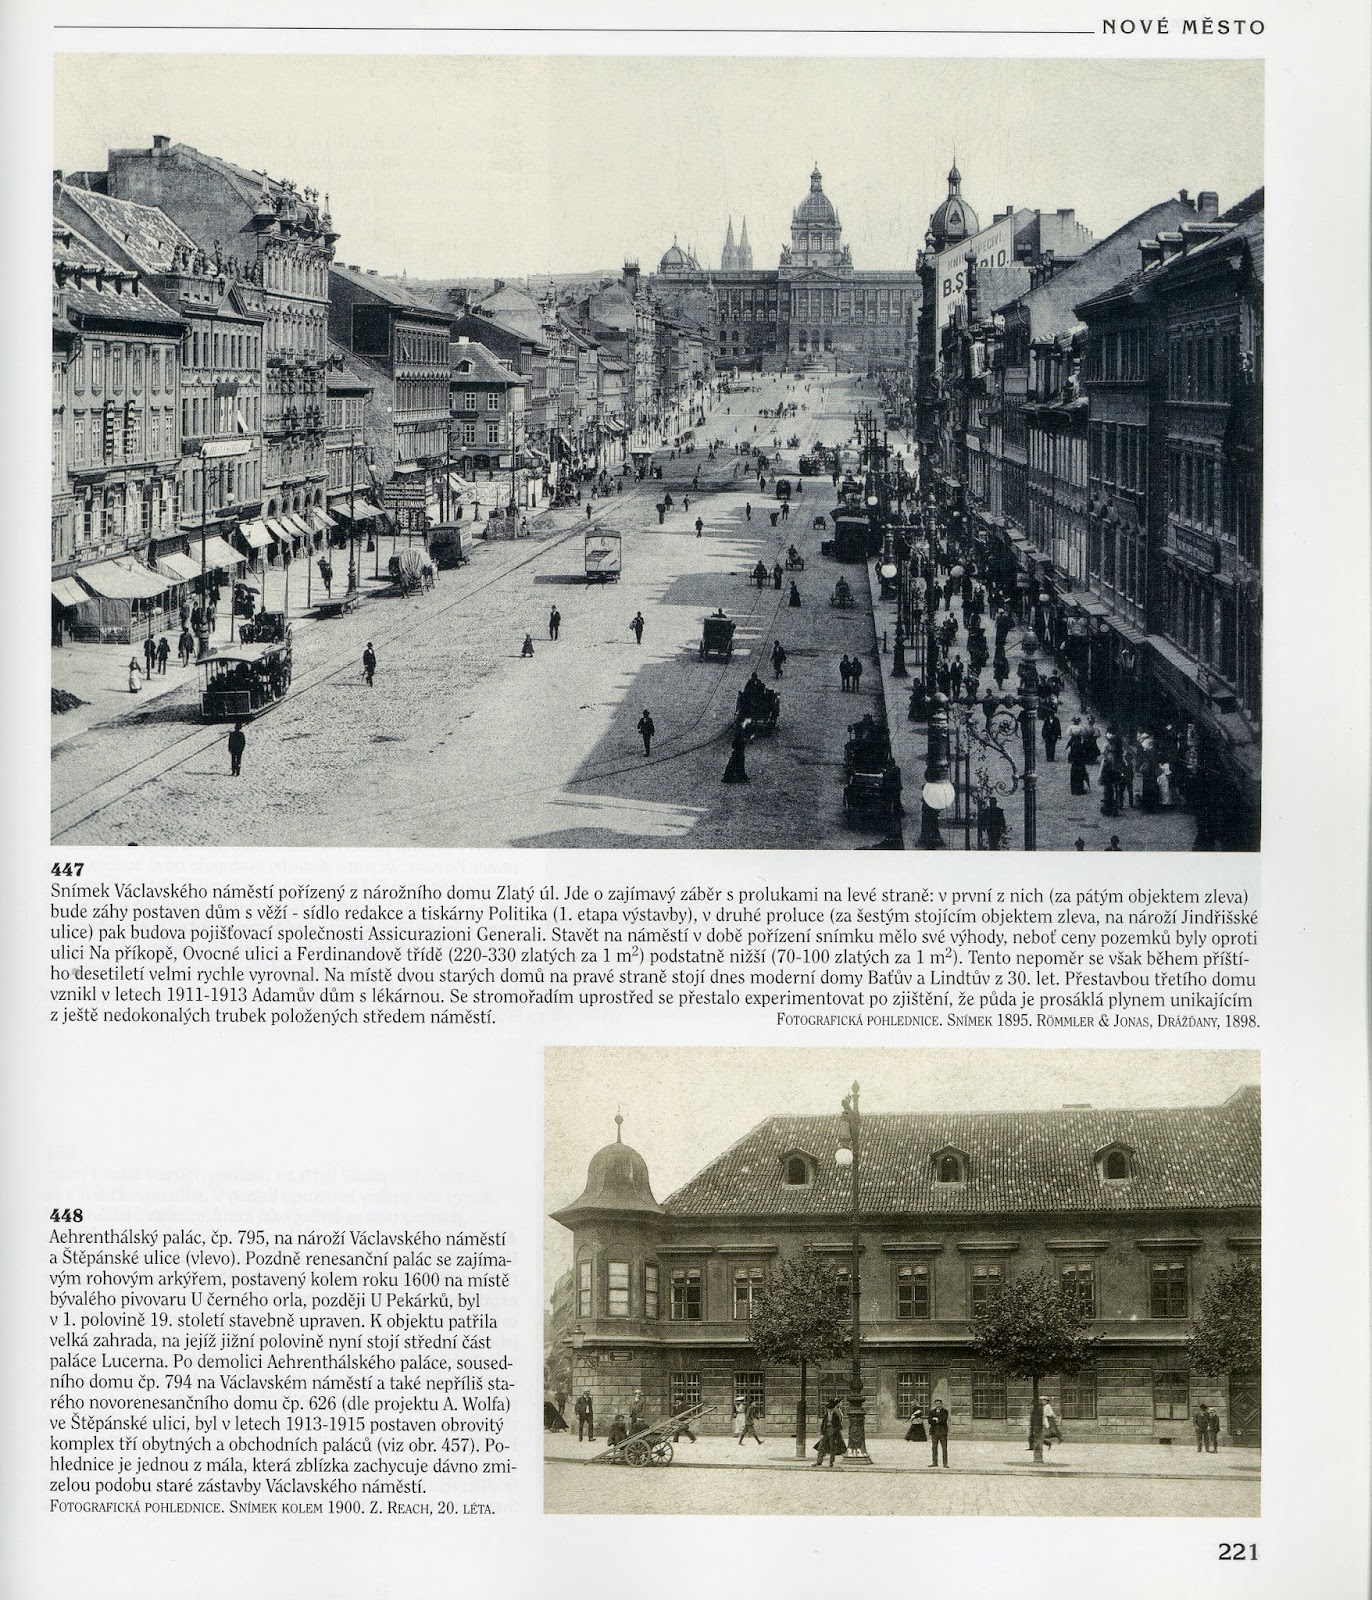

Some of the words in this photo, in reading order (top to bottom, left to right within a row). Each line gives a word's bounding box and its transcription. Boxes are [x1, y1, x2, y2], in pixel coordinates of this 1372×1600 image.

[1102, 16, 1169, 35] NOVÉ
[1181, 16, 1265, 35] MĚSTO
[600, 537, 606, 547] 6
[50, 862, 85, 877] 447
[50, 882, 111, 898] Snímek
[114, 882, 208, 899] Václavského
[212, 883, 275, 899] náměstí
[278, 884, 346, 903] pořízený
[349, 888, 358, 900] z
[363, 884, 442, 900] nárožního
[446, 884, 491, 900] domu
[496, 884, 535, 904] Zlatý
[539, 884, 559, 901] úl.
[563, 885, 589, 901] Jde
[593, 889, 604, 901] o
[607, 885, 676, 904] zajímavý
[680, 885, 723, 902] záběr
[726, 890, 734, 902] s
[738, 886, 819, 905] prolukami
[823, 890, 843, 902] na
[847, 886, 877, 902] levé
[881, 887, 934, 903] straně:
[938, 891, 948, 903] v
[951, 887, 993, 906] první
[996, 892, 1005, 903] z
[1009, 887, 1044, 903] nich
[1049, 887, 1072, 906] (za
[1076, 888, 1124, 907] pátým
[1128, 888, 1200, 907] objektem
[1204, 888, 1249, 905] zleva)
[50, 923, 94, 942] ulice)
[98, 924, 126, 943] pak
[130, 924, 186, 940] budova
[190, 924, 274, 943] pojišťovací
[277, 924, 364, 944] společnosti
[367, 925, 471, 942] Assicurazioni
[476, 926, 546, 942] Generali.
[551, 926, 600, 942] Stavět
[604, 931, 623, 943] na
[627, 927, 689, 943] náměstí
[692, 931, 702, 943] v
[706, 927, 743, 943] době
[747, 928, 812, 946] pořízení
[815, 927, 874, 944] snímku
[879, 928, 918, 944] mělo
[921, 928, 946, 944] své
[949, 928, 1008, 947] výhody,
[1012, 928, 1057, 945] neboť
[1060, 933, 1097, 948] ceny
[1100, 929, 1171, 948] pozemků
[1175, 929, 1207, 949] byly
[1211, 930, 1258, 949] oproti
[50, 964, 70, 981] ho
[74, 964, 145, 981] desetiletí
[148, 965, 192, 981] velmi
[197, 965, 245, 985] rychle
[248, 966, 319, 985] vyrovnal.
[324, 966, 346, 982] Na
[349, 967, 393, 983] místě
[397, 966, 435, 983] dvou
[439, 967, 496, 986] starých
[500, 967, 545, 983] domů
[549, 972, 569, 984] na
[573, 968, 615, 987] pravé
[618, 968, 667, 984] straně
[671, 968, 706, 987] stojí
[709, 968, 746, 985] dnes
[750, 968, 816, 985] moderní
[820, 969, 863, 988] domy
[867, 969, 913, 985] Baťův
[916, 974, 926, 985] a
[930, 969, 991, 986] Lindtův
[994, 974, 1004, 986] z
[1007, 970, 1031, 986] 30.
[1035, 970, 1060, 986] let.
[1065, 970, 1150, 987] Přestavbou
[1154, 970, 1207, 987] třetího
[1211, 971, 1256, 987] domu
[50, 1011, 59, 1022] z
[61, 1006, 99, 1025] ještě
[103, 1006, 211, 1026] nedokonalých
[215, 1007, 267, 1023] trubek
[270, 1007, 359, 1027] položených
[362, 1008, 426, 1024] středem
[430, 1008, 496, 1025] náměstí.
[776, 1012, 864, 1026] FOTOGRAFICKÁ
[867, 1015, 943, 1027] POHLEDNICE.
[947, 1012, 993, 1027] SNÍMEK
[997, 1013, 1029, 1027] 1895.
[1036, 1013, 1095, 1027] RÖMMLER
[1098, 1013, 1110, 1028] &
[1113, 1013, 1153, 1030] JONAS,
[1157, 1014, 1221, 1030] DRÁŽĎANY,
[1225, 1014, 1260, 1028] 1898.
[49, 1208, 84, 1223] 448
[48, 1228, 159, 1248] Aehrenthálský
[162, 1229, 206, 1248] palác,
[210, 1229, 233, 1248] čp.
[237, 1229, 270, 1248] 795,
[274, 1234, 294, 1245] na
[297, 1230, 346, 1246] nároží
[349, 1229, 442, 1246] Václavského
[445, 1231, 507, 1247] náměstí
[48, 1270, 82, 1288] vým
[86, 1269, 154, 1289] rohovým
[158, 1270, 227, 1289] arkýřem,
[231, 1271, 307, 1290] postavený
[310, 1271, 358, 1287] kolem
[362, 1271, 399, 1287] roku
[404, 1272, 440, 1288] 1600
[444, 1276, 464, 1288] na
[467, 1272, 510, 1288] místě
[49, 1352, 97, 1371] paláce
[101, 1353, 168, 1369] Lucerna.
[173, 1353, 193, 1369] Po
[197, 1353, 263, 1369] demolici
[266, 1353, 396, 1370] Aehrenthálského
[400, 1354, 452, 1373] paláce,
[456, 1354, 514, 1371] soused-
[49, 1418, 66, 1430] ve
[70, 1412, 148, 1433] Štěpánské
[152, 1415, 190, 1433] ulici,
[194, 1415, 218, 1434] byl
[221, 1419, 231, 1431] v
[234, 1415, 281, 1431] letech
[286, 1415, 366, 1432] 1913-1915
[369, 1417, 437, 1435] postaven
[441, 1416, 504, 1436] obrovitý
[49, 1476, 91, 1492] zelou
[95, 1476, 152, 1495] podobu
[156, 1477, 193, 1493] staré
[197, 1477, 262, 1496] zástavby
[265, 1477, 357, 1494] Václavského
[361, 1478, 427, 1494] náměstí.
[49, 1498, 141, 1513] FOTOGRAFICKÁ
[144, 1502, 225, 1514] POHLEDNICE.
[229, 1499, 278, 1514] SNÍMEK
[281, 1503, 323, 1514] KOLEM
[328, 1500, 365, 1514] 1900.
[369, 1500, 383, 1514] Z.
[387, 1500, 433, 1517] REACH,
[437, 1500, 459, 1515] 20.
[463, 1501, 495, 1515] LÉTA.
[1218, 1542, 1258, 1561] 221
